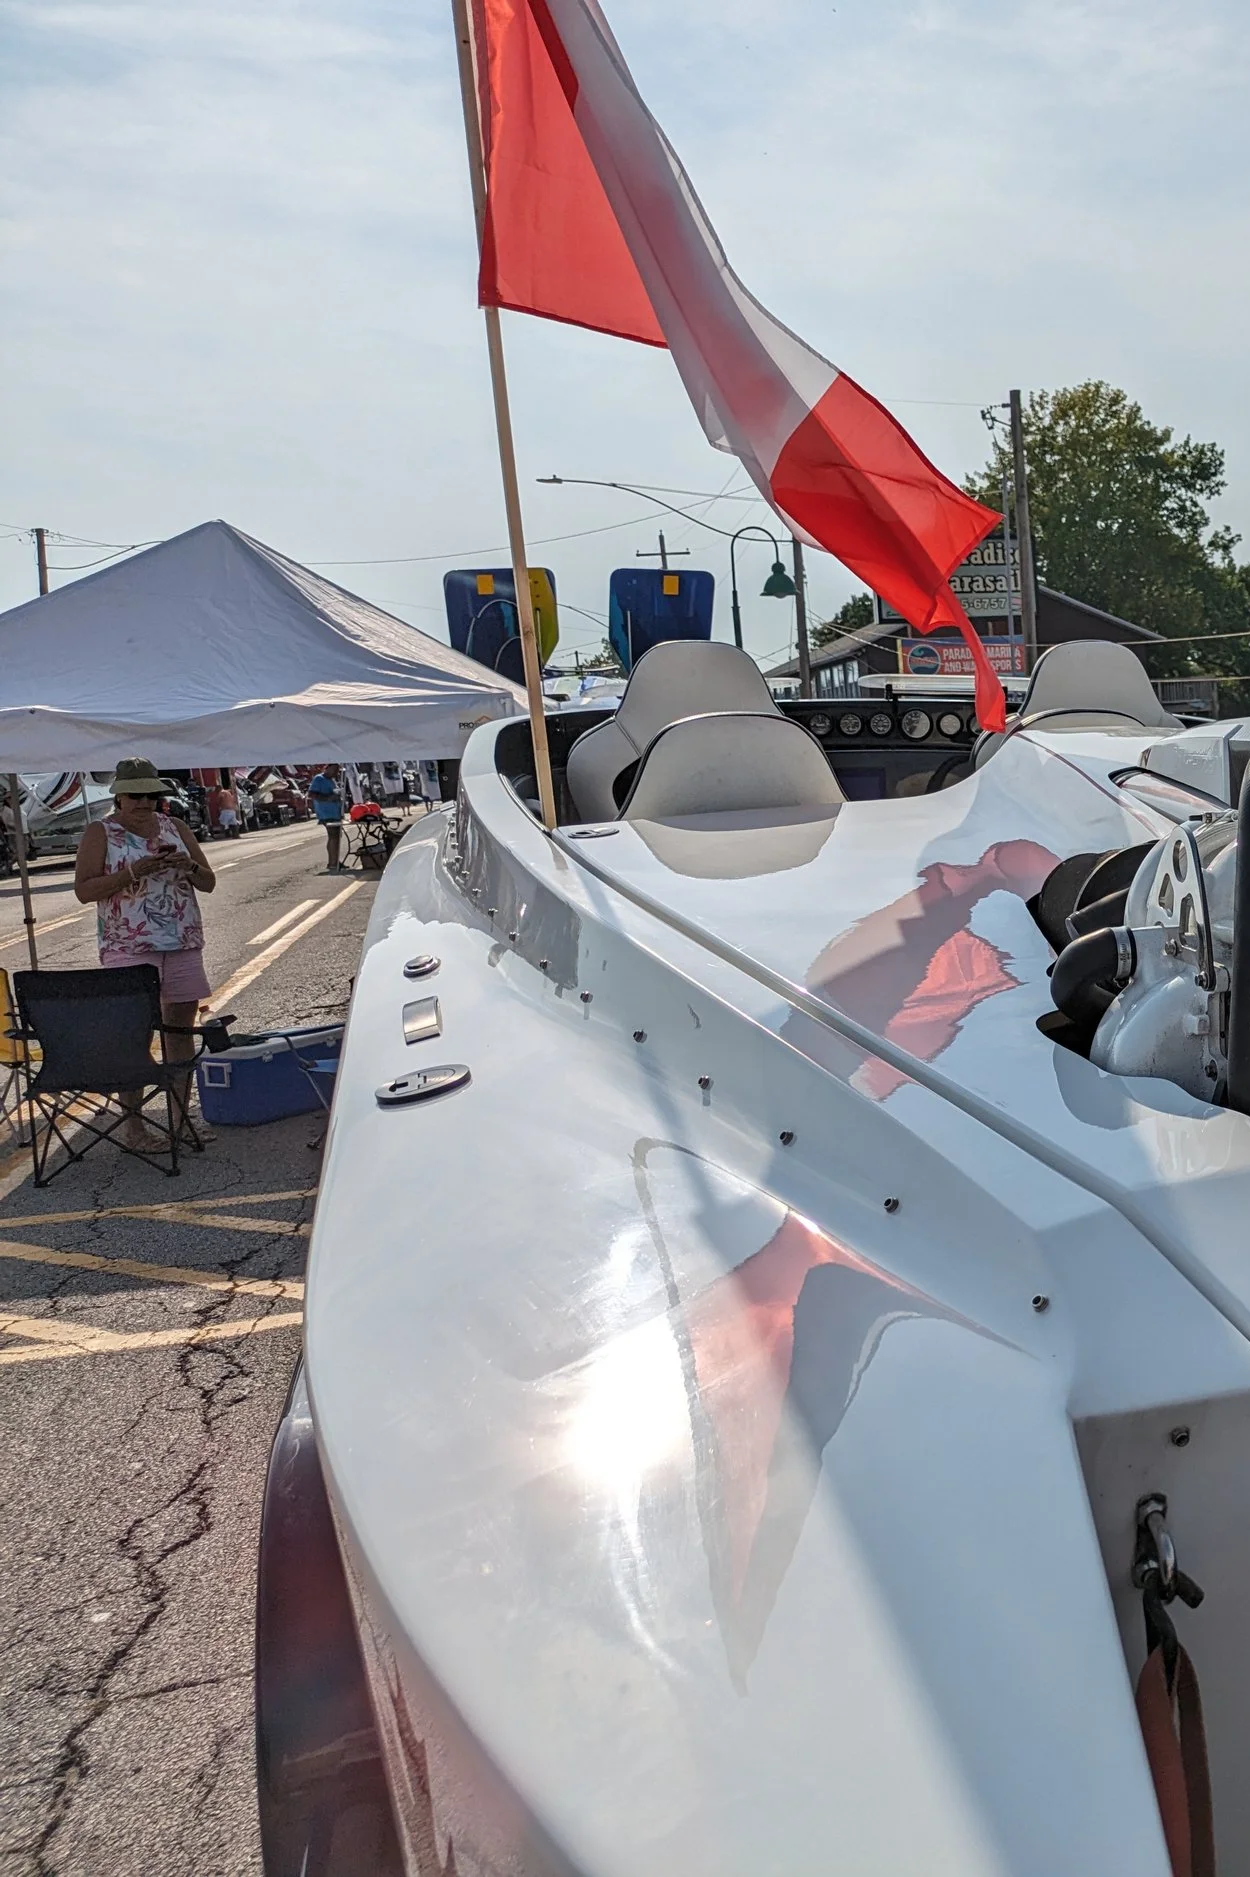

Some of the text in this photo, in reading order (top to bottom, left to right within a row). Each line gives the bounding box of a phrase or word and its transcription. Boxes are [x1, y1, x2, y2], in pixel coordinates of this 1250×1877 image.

[948, 569, 1021, 592] arasail
[943, 647, 973, 660] PARAD
[944, 662, 961, 672] AND
